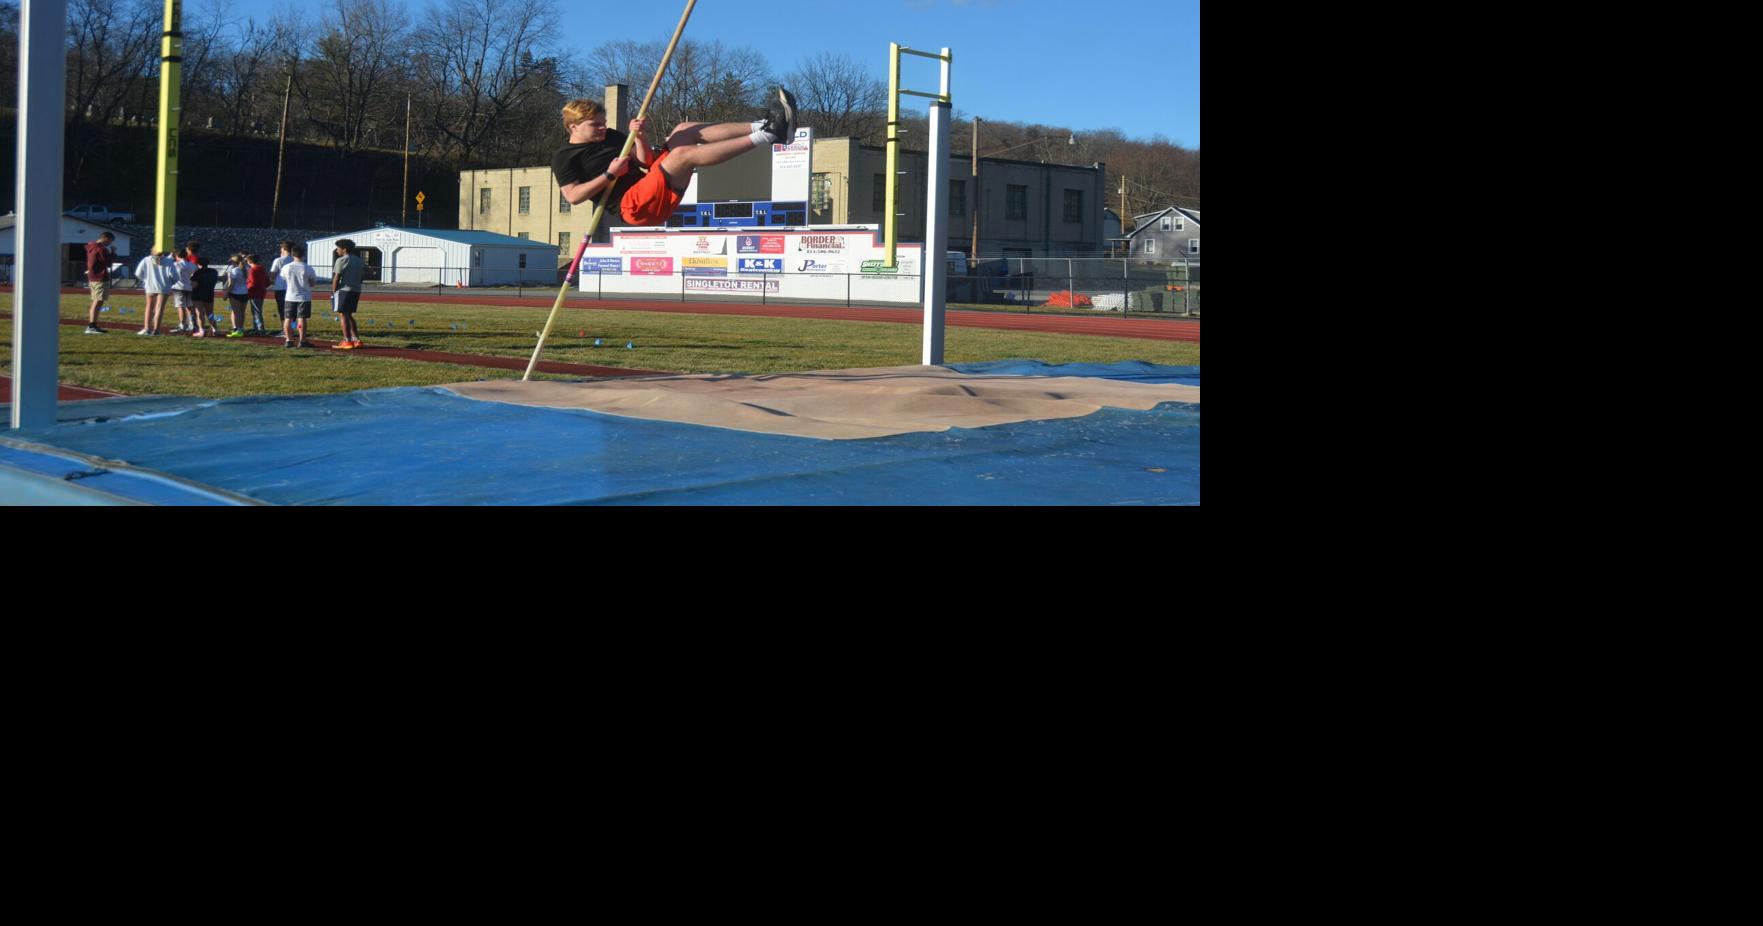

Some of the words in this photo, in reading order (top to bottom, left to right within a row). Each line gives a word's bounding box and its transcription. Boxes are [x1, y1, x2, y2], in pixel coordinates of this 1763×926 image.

[801, 235, 836, 244] BORDER
[744, 259, 776, 269] K&K
[686, 280, 738, 289] SINGLETON
[740, 280, 779, 289] RENTAL
